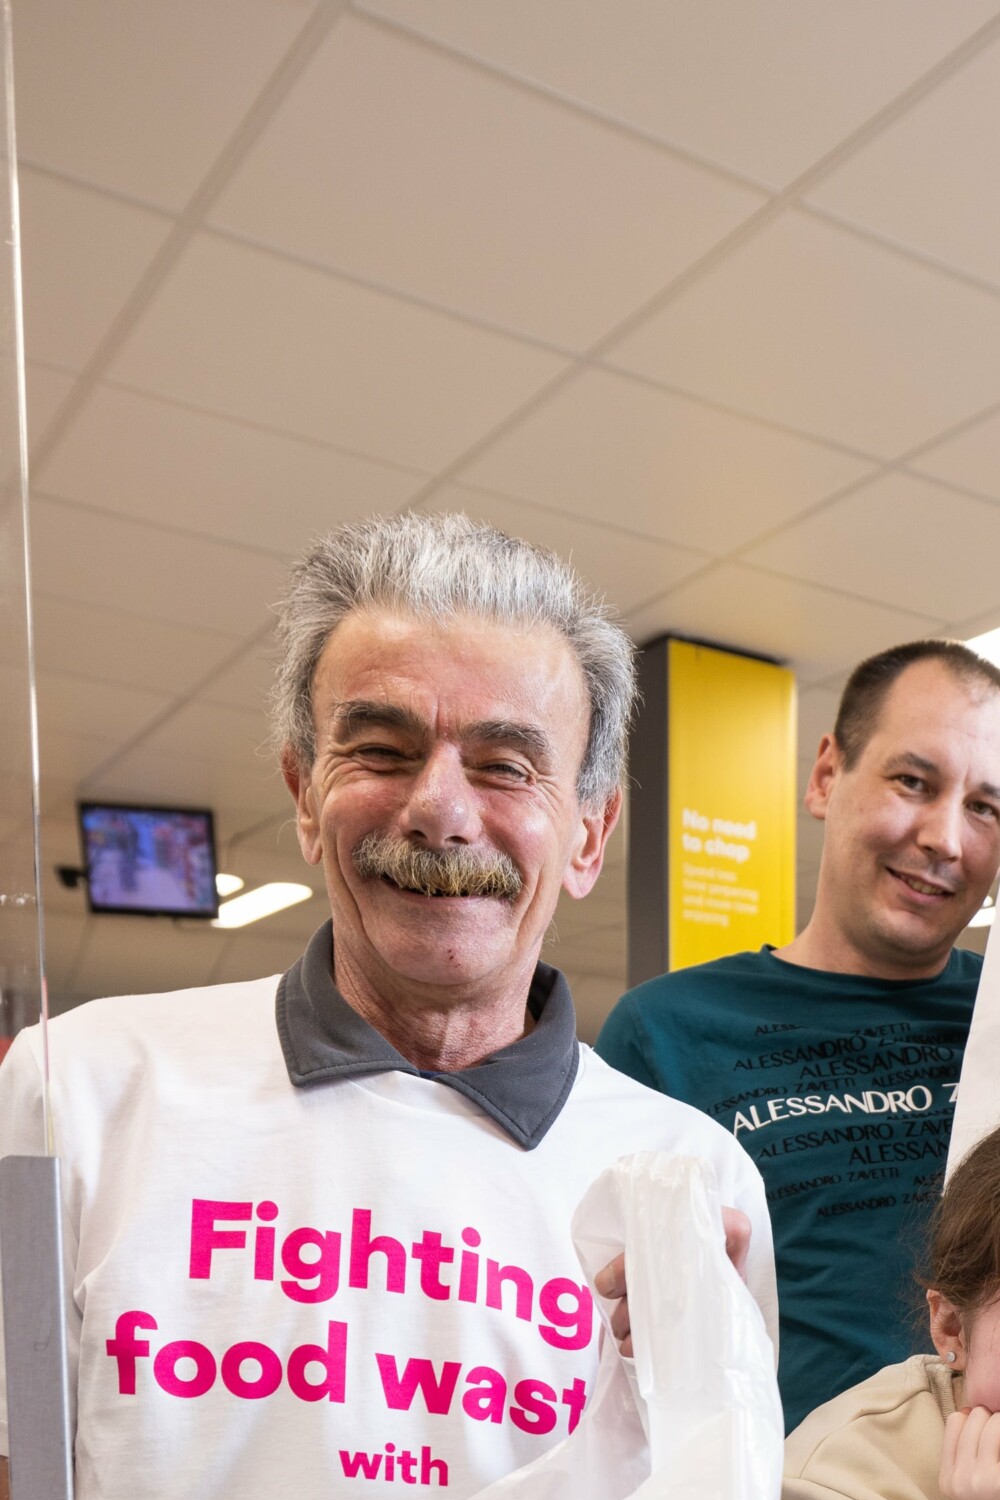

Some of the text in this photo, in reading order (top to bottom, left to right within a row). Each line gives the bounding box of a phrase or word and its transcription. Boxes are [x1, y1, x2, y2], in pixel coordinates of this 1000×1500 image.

[733, 1035, 868, 1072] ALESSANDRO
[800, 1045, 955, 1080] ALESSANDRO
[732, 1084, 934, 1136] ALESSANDRO
[757, 1119, 952, 1160] ALESSANDRO ZAVE
[848, 1139, 949, 1166] ALESSAN
[188, 1197, 593, 1350] Fighting
[105, 1310, 587, 1435] food wast
[339, 1441, 450, 1487] with
